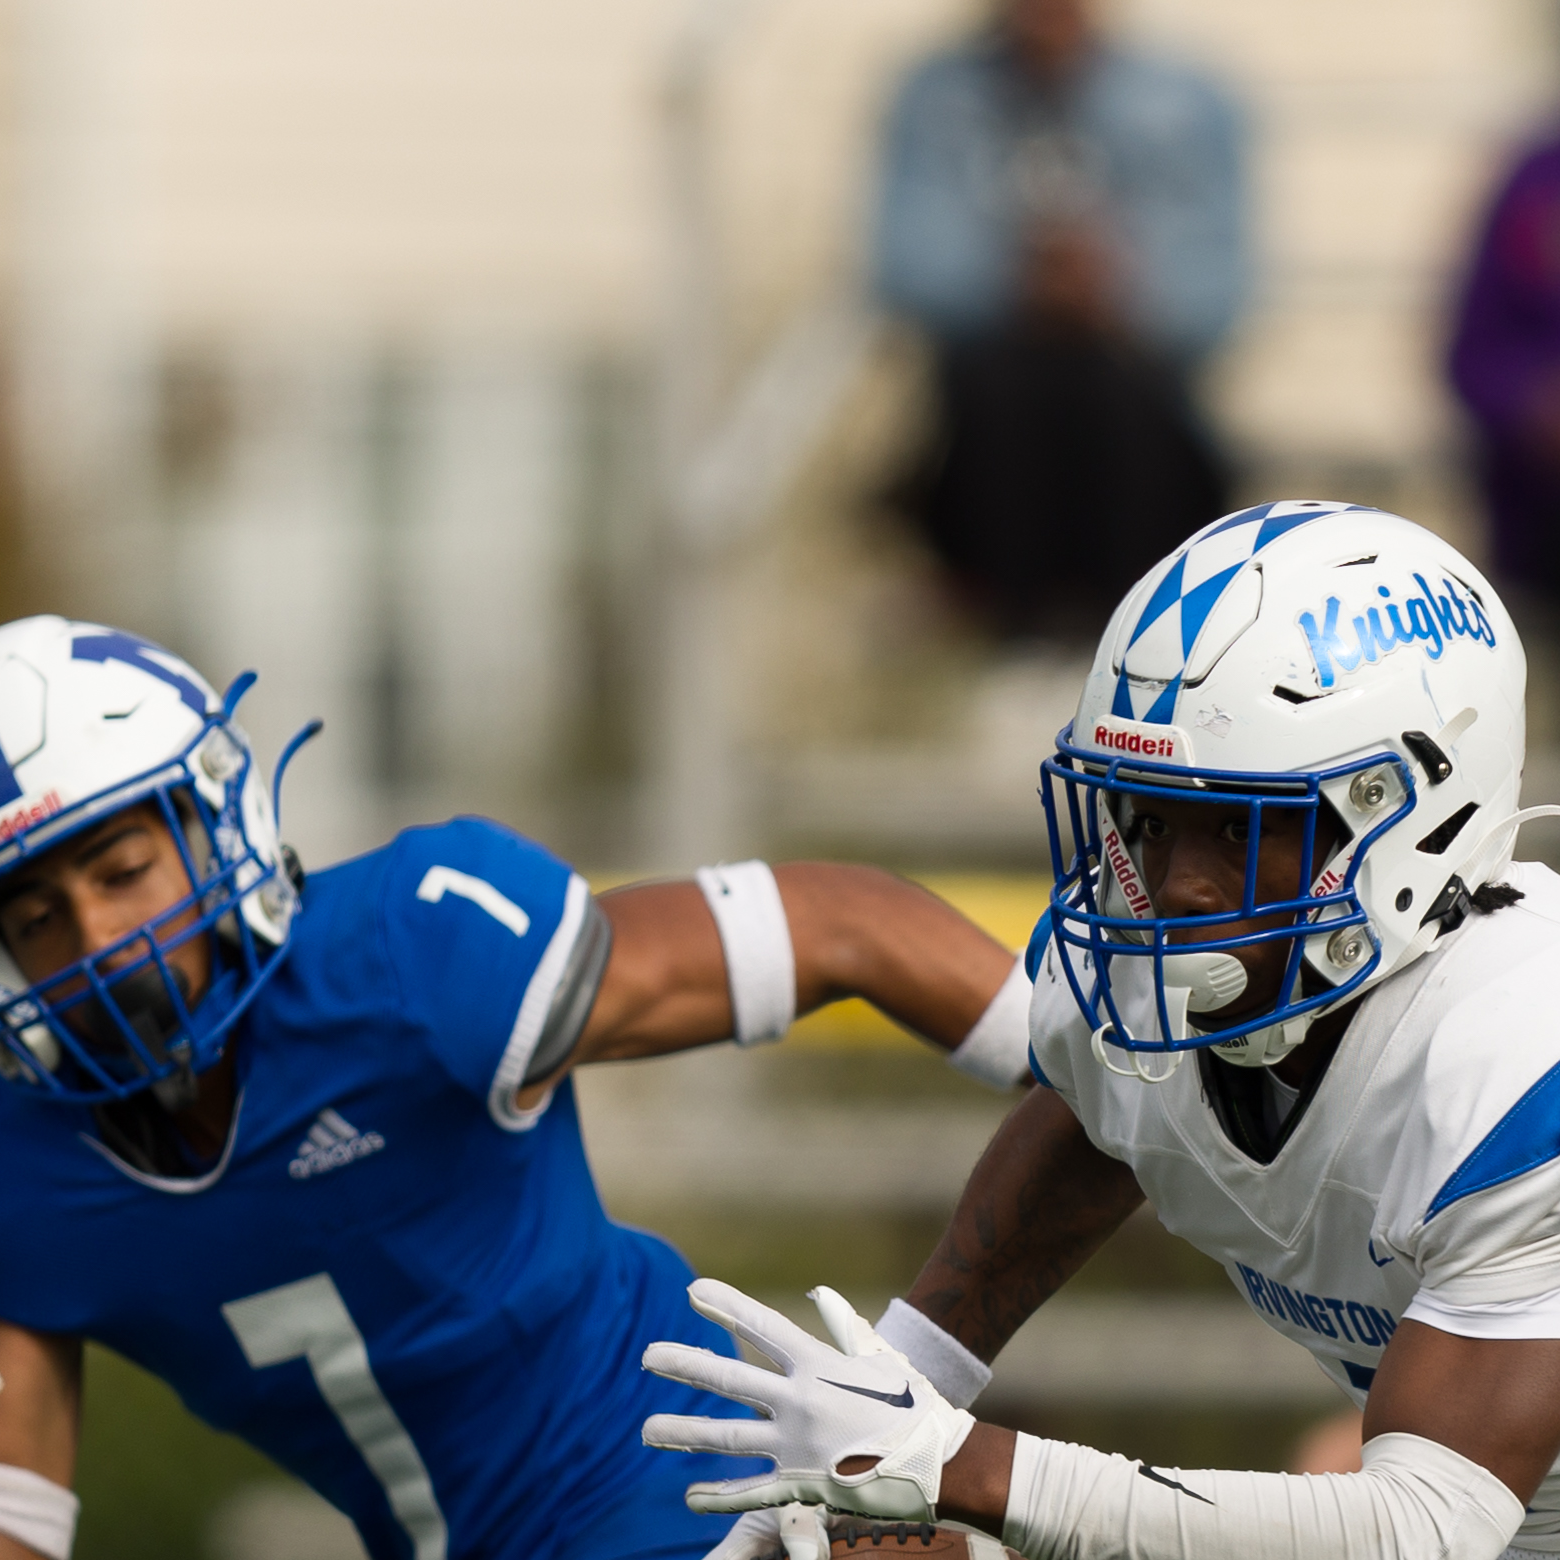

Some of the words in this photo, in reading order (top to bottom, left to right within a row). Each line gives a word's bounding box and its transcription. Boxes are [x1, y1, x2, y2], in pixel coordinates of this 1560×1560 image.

[1298, 572, 1497, 687] Knights
[1094, 725, 1174, 757] Riddell
[1104, 828, 1151, 913] Riddell
